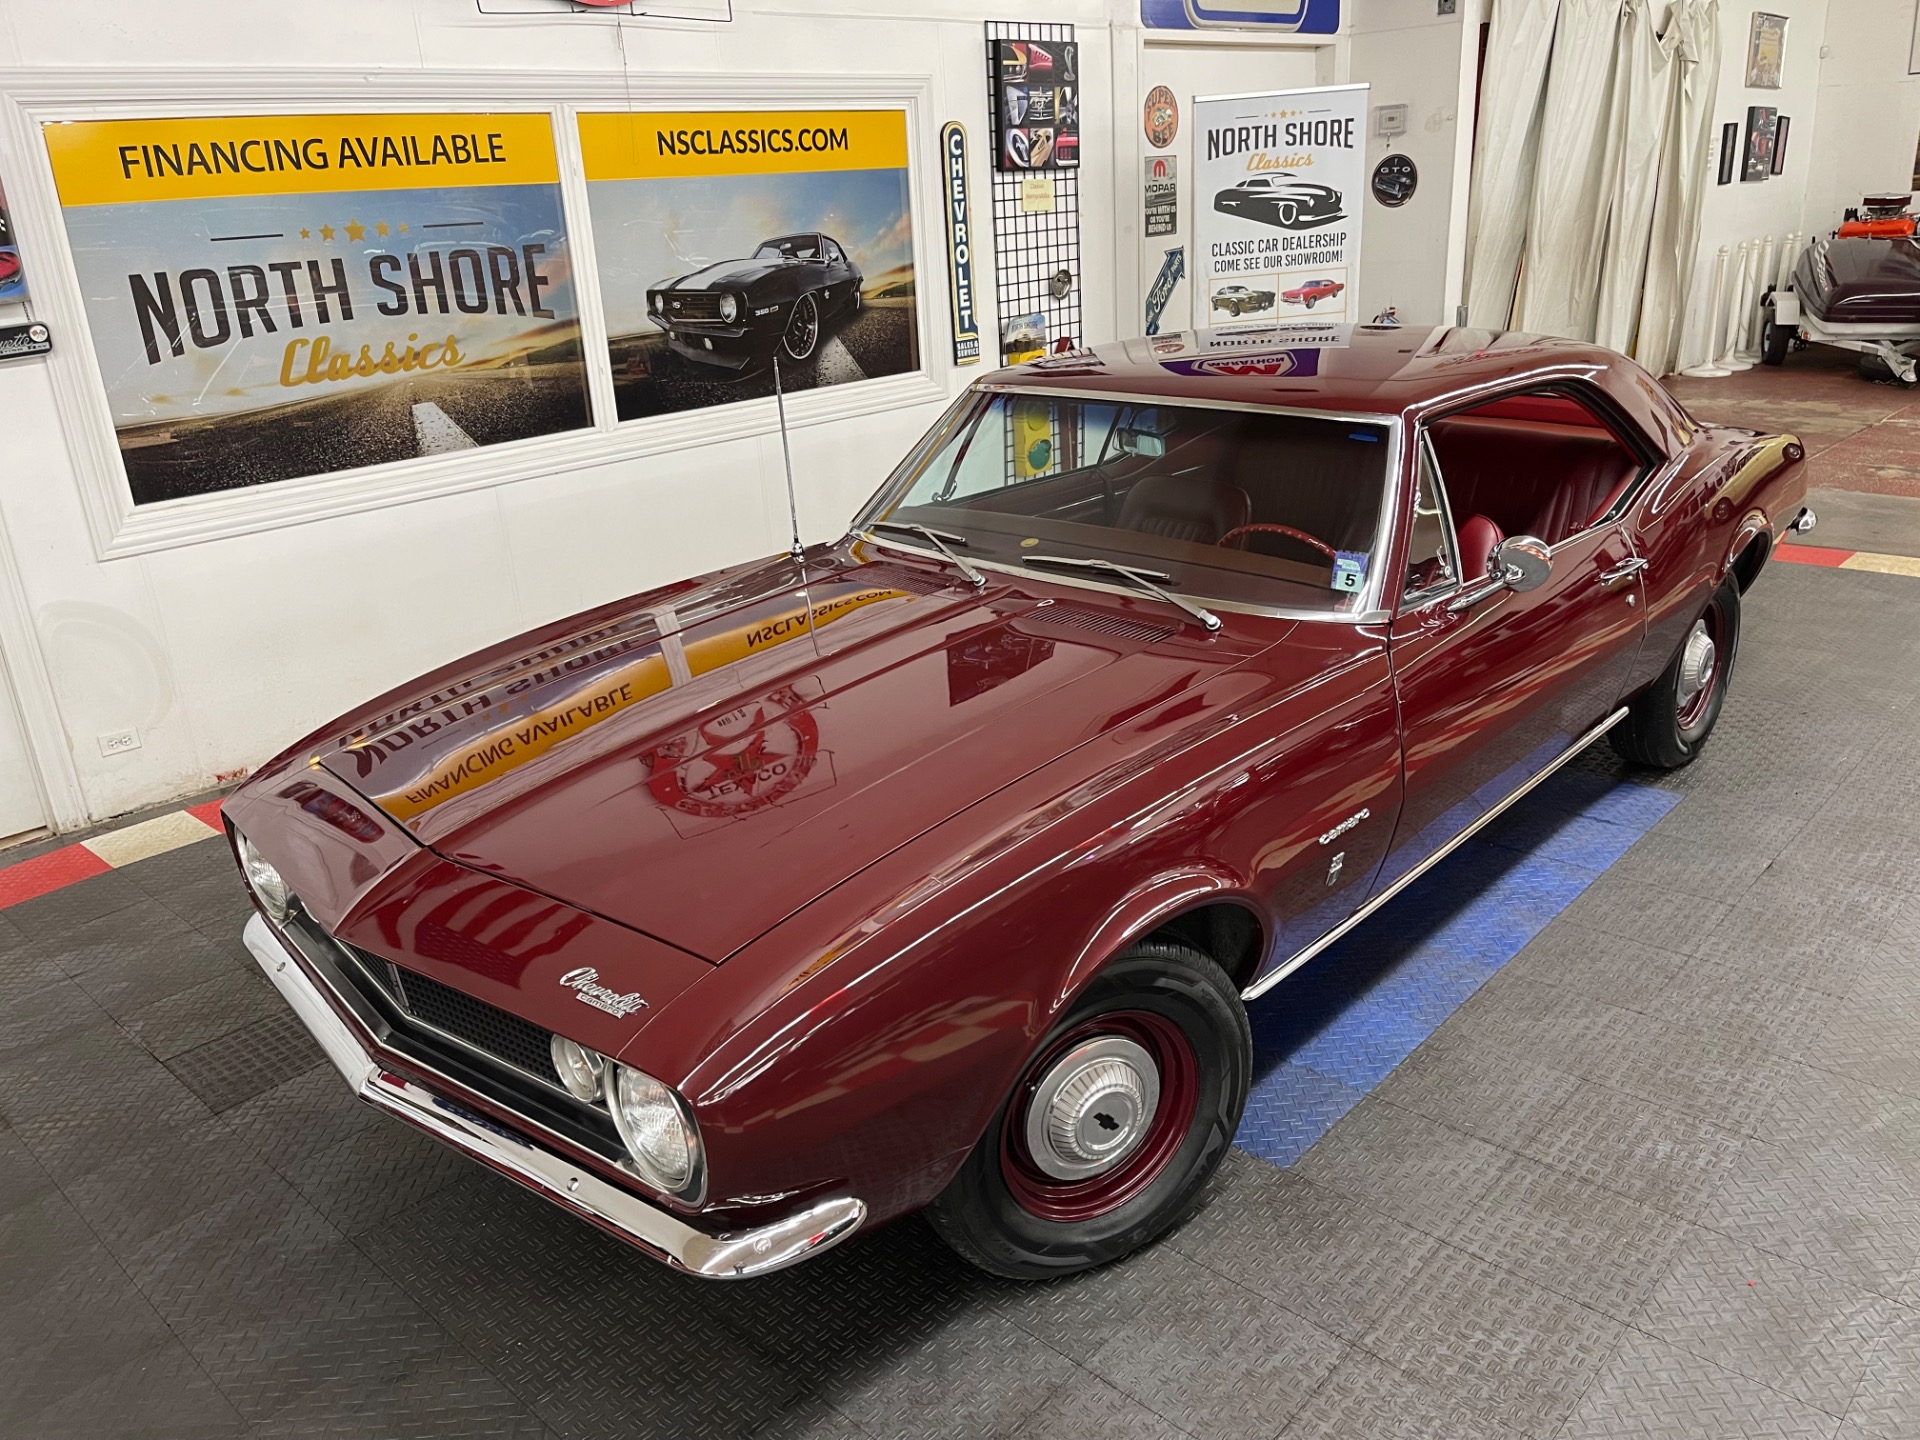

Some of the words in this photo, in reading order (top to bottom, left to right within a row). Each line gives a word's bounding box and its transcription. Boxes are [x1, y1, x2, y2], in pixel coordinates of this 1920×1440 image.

[656, 128, 849, 156] NSCLASSICS.COM
[1152, 122, 1174, 145] BEE
[1207, 124, 1277, 161] NORTH
[1285, 118, 1355, 149] SHORE
[118, 139, 329, 179] FINANCING
[338, 133, 507, 169] AVAILABLE
[1246, 152, 1315, 171] Classics
[1380, 166, 1411, 174] GTO
[1145, 183, 1176, 193] MOPAR
[1157, 205, 1171, 214] WITH
[950, 134, 971, 329] CHEVROLET
[1148, 223, 1166, 233] BEHIND
[1211, 240, 1255, 257] CLASSIC
[1258, 238, 1279, 253] CAR
[1282, 232, 1347, 251] DEALERSHIP
[1214, 258, 1241, 273] COME
[1243, 257, 1260, 270] SEE
[1263, 255, 1282, 268] OUR
[1285, 250, 1343, 266] SHOWROOM!
[1152, 270, 1174, 313] Ford
[128, 257, 356, 366] NORTH
[371, 243, 557, 321] SHORE
[957, 341, 973, 350] SALES
[957, 347, 979, 358] SERVICE
[279, 332, 466, 388] Classics
[1344, 573, 1357, 587] 5
[559, 967, 650, 1015] Chevrolet
[580, 994, 619, 1015] camaro
